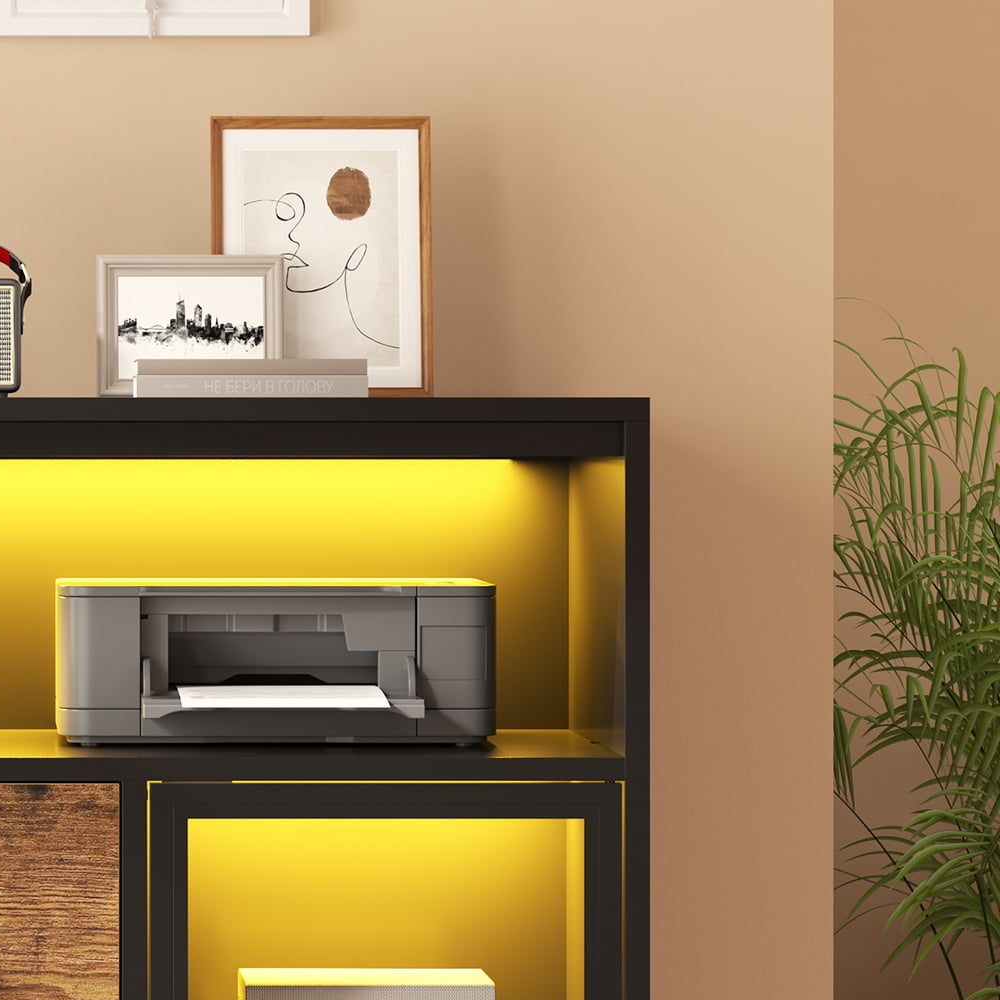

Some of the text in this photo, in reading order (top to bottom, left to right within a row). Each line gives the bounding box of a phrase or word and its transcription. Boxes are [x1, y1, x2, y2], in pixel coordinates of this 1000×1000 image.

[204, 380, 335, 394] НЕ БЕРИ В ГОЛОВУ
